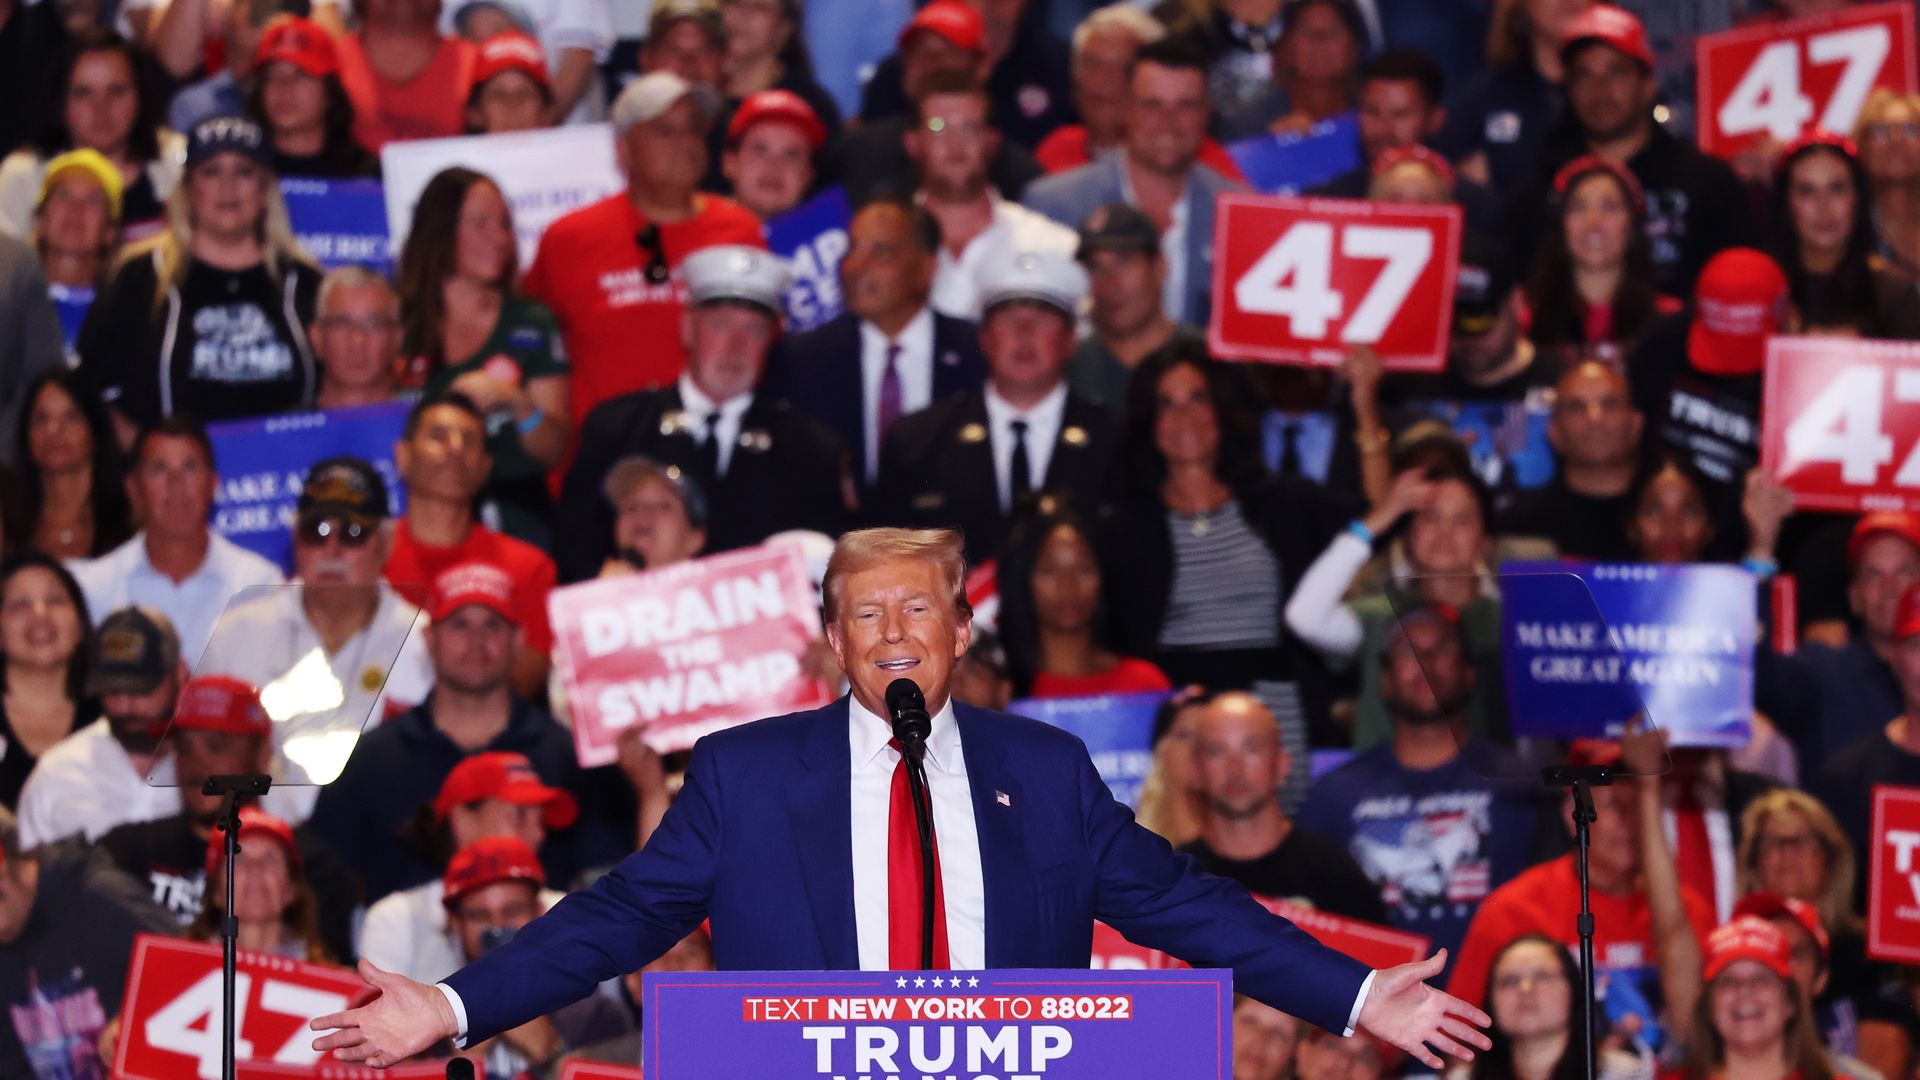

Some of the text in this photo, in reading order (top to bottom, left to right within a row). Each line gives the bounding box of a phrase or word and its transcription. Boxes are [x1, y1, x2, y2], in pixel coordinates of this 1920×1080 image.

[1717, 23, 1890, 141] 47
[1234, 220, 1434, 345] 47
[581, 571, 783, 658] DRAIN
[1516, 622, 1738, 653] MAKE AMERICA
[659, 635, 723, 671] THE
[1529, 655, 1721, 686] GREAT AGAIN
[596, 650, 800, 729] SWAMP
[143, 966, 349, 1080] 47
[746, 996, 1130, 1021] TEXT NEW YORK TO 88022
[802, 1025, 1073, 1074] TRUMP
